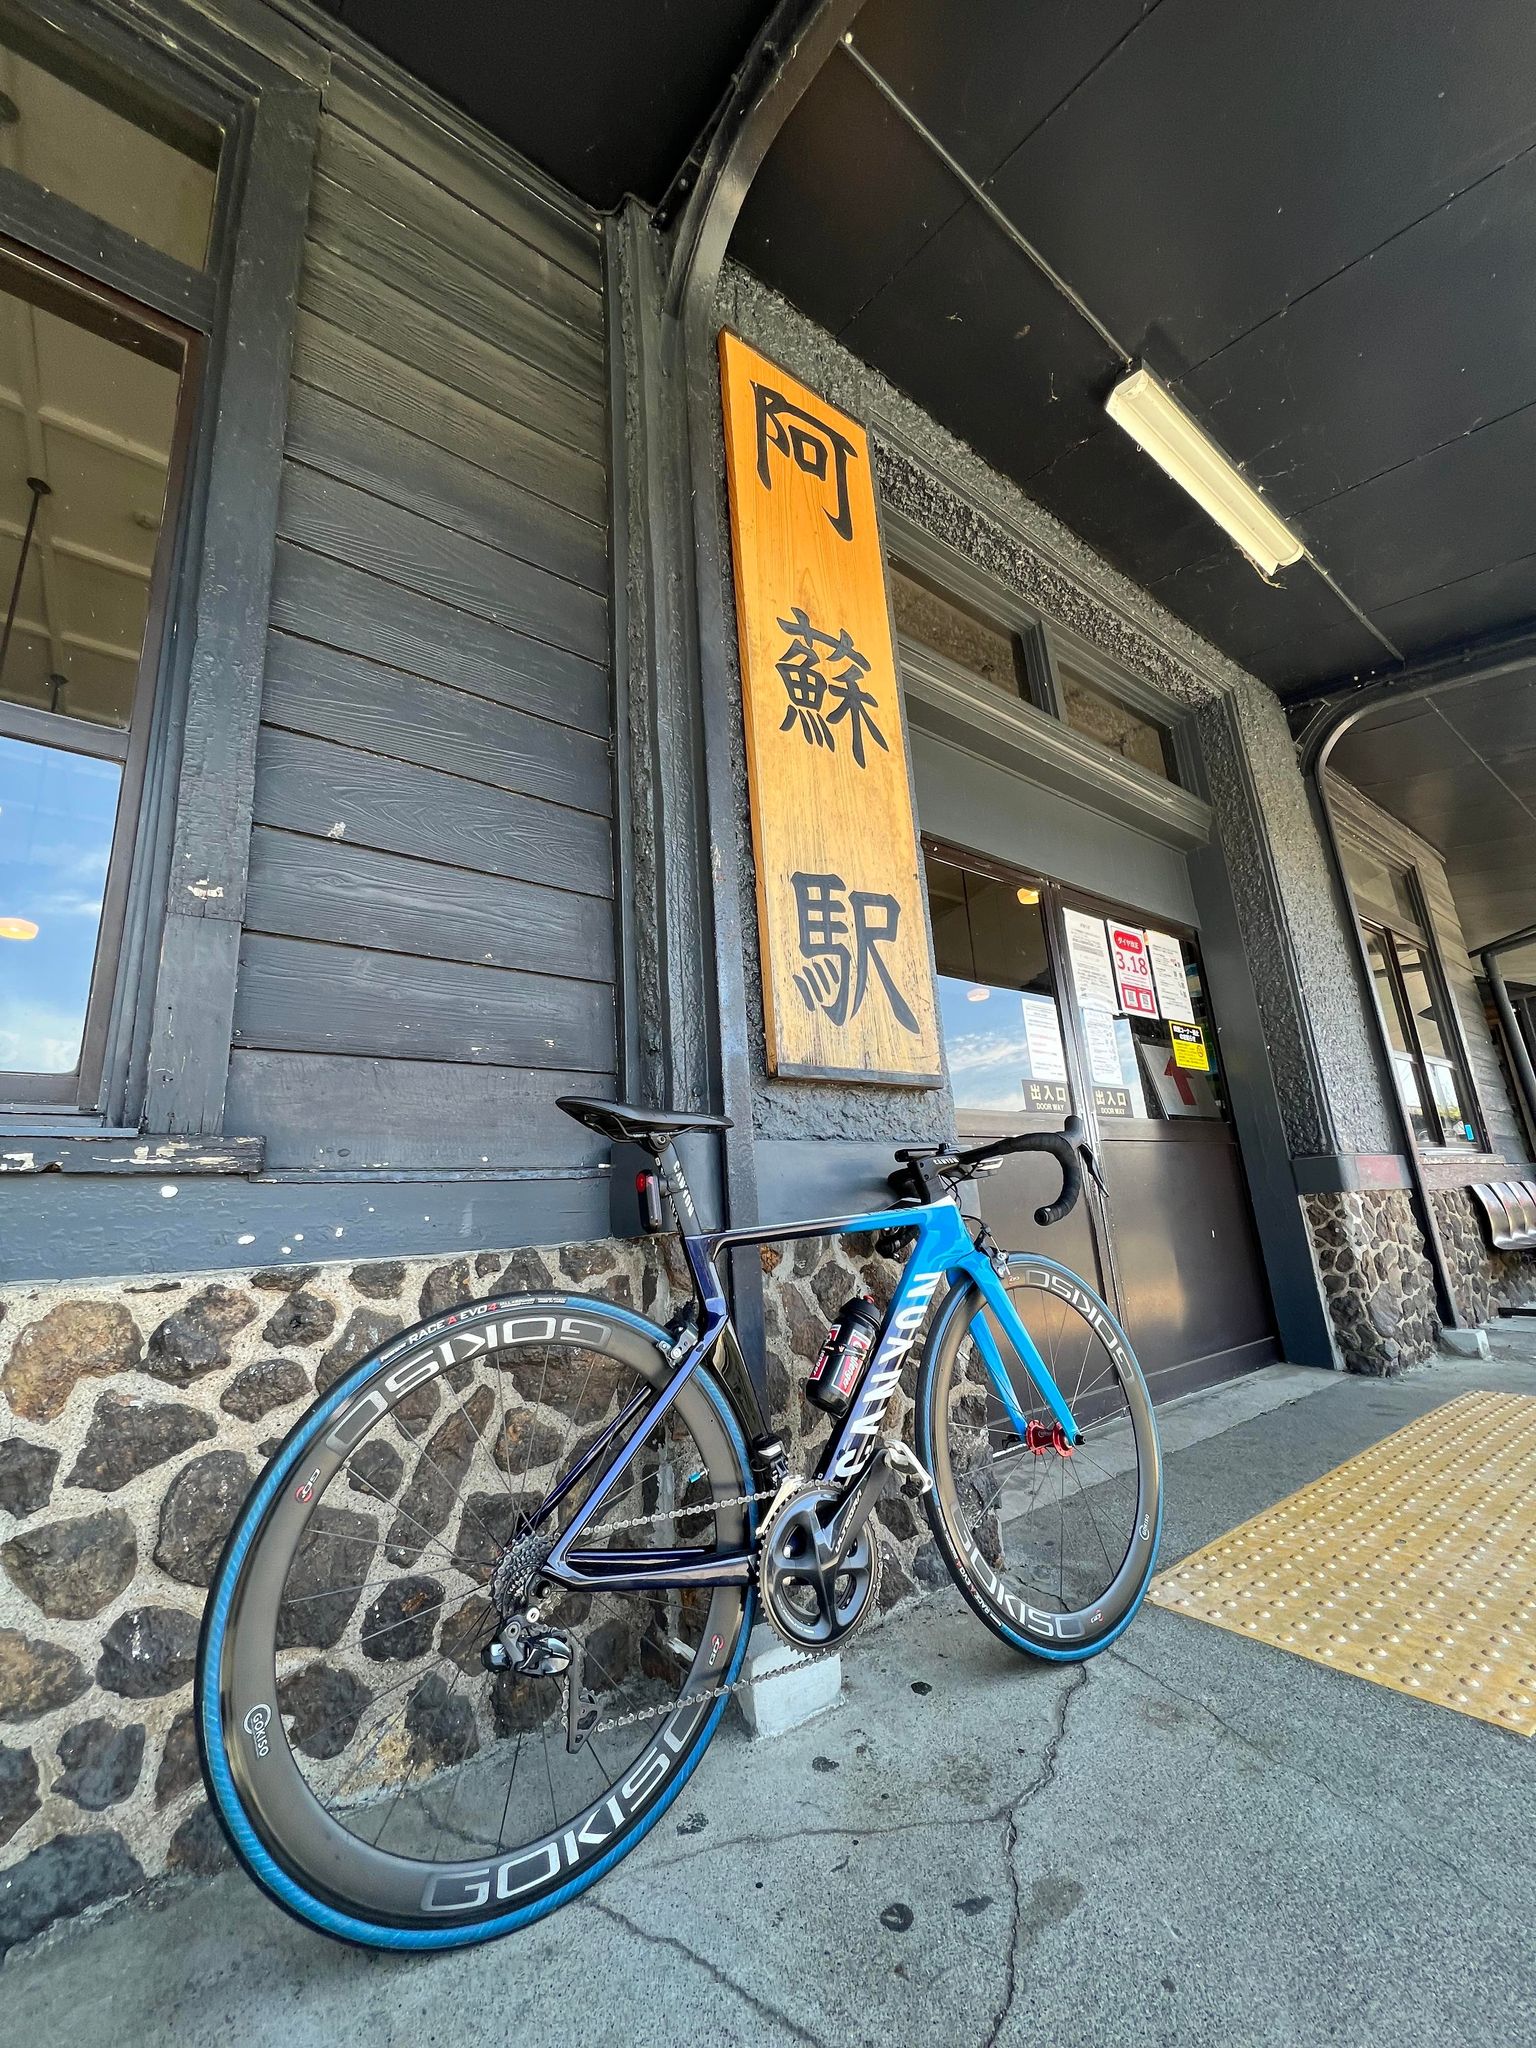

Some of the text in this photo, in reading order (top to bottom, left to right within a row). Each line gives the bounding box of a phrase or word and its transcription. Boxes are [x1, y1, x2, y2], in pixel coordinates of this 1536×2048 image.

[750, 378, 920, 1035] 阿蘇駅
[1115, 951, 1148, 976] 3.18
[1030, 1084, 1067, 1103] 出入口
[1095, 1089, 1127, 1106] 出入口
[672, 1160, 695, 1218] CANYON
[408, 1320, 446, 1345] RACE
[447, 1315, 457, 1326] A
[1025, 1269, 1135, 1384] GOKISO
[325, 1316, 613, 1452] GOKISO
[834, 1271, 942, 1478] CANYON
[950, 1502, 1086, 1639] GOKISO
[253, 1712, 269, 1757] GOKISO
[420, 1693, 708, 1912] GOKISO
